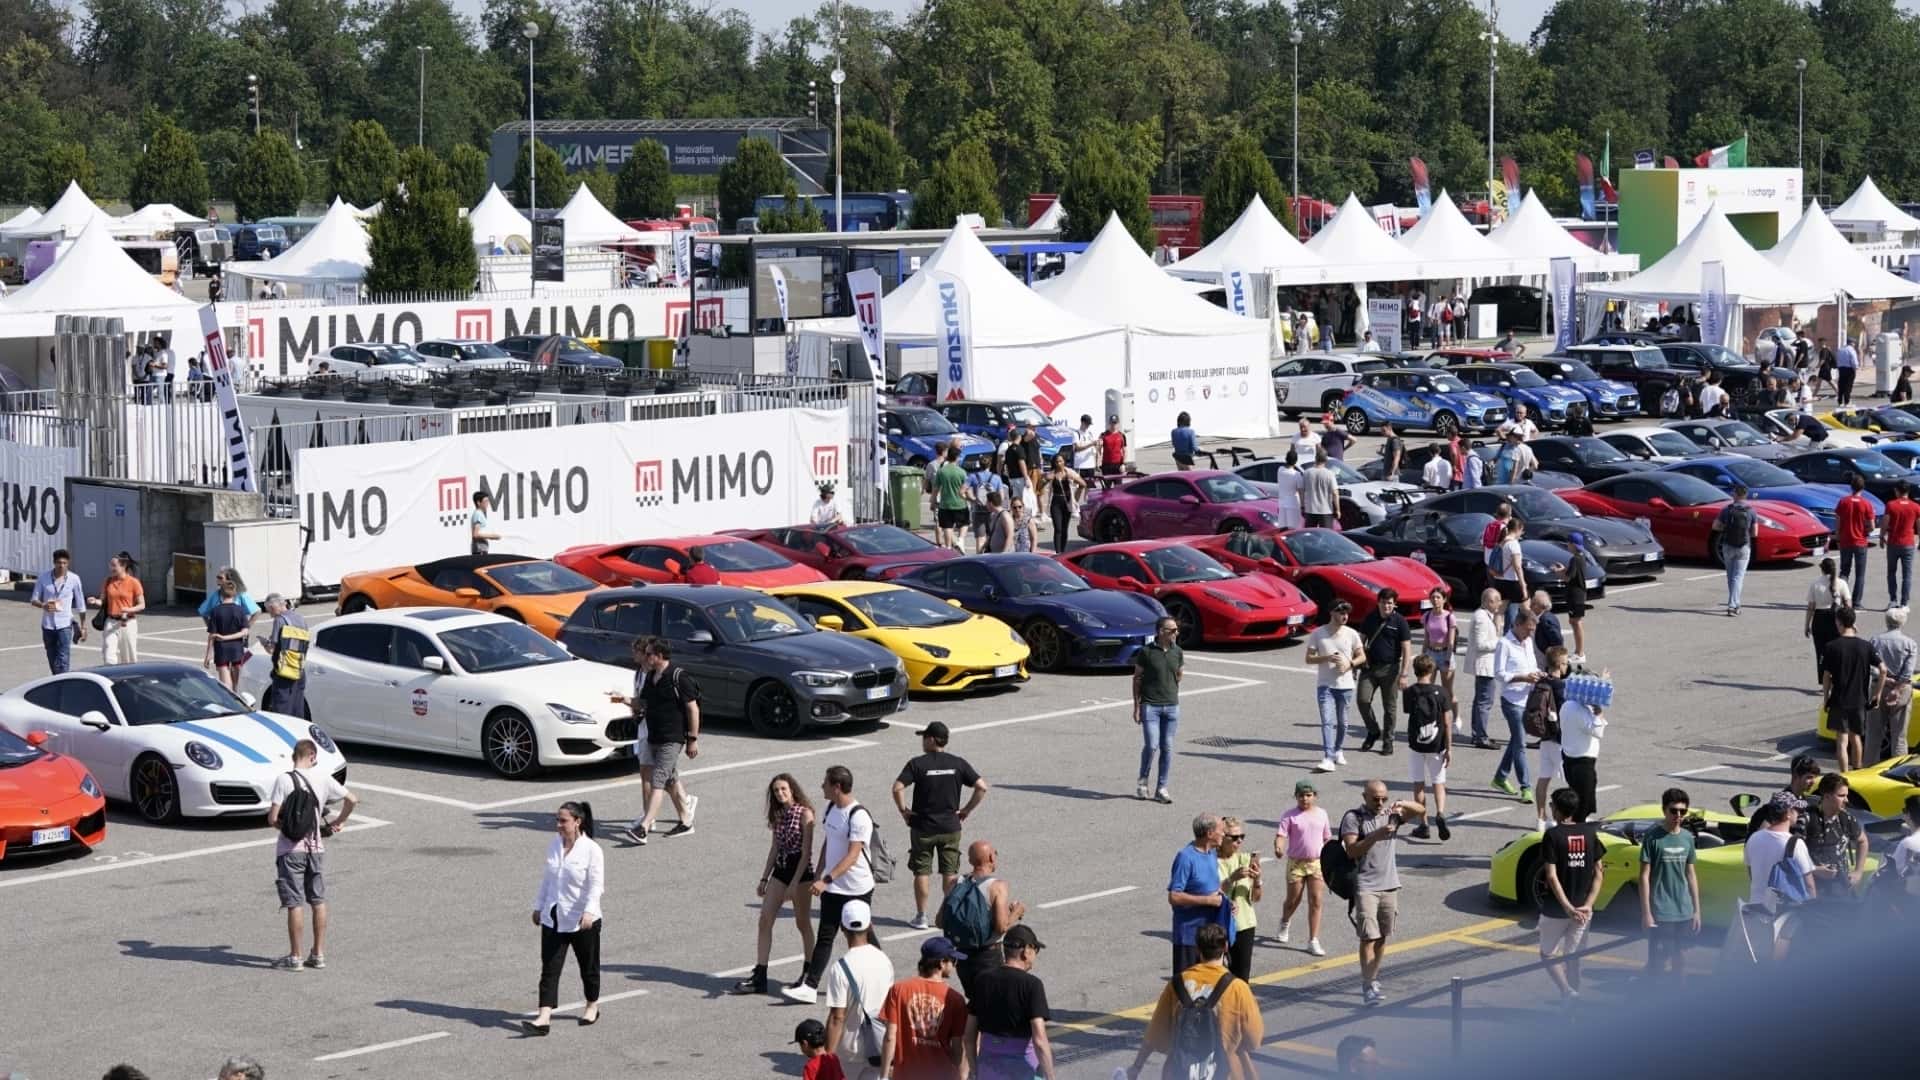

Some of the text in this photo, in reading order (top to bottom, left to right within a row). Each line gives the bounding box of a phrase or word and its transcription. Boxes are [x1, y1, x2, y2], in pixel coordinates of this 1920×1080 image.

[675, 155, 695, 164] takes
[696, 157, 711, 166] you
[480, 466, 589, 521] MIMO
[672, 450, 774, 504] MIMO
[3, 482, 60, 535] IMO
[306, 486, 388, 543] IMO
